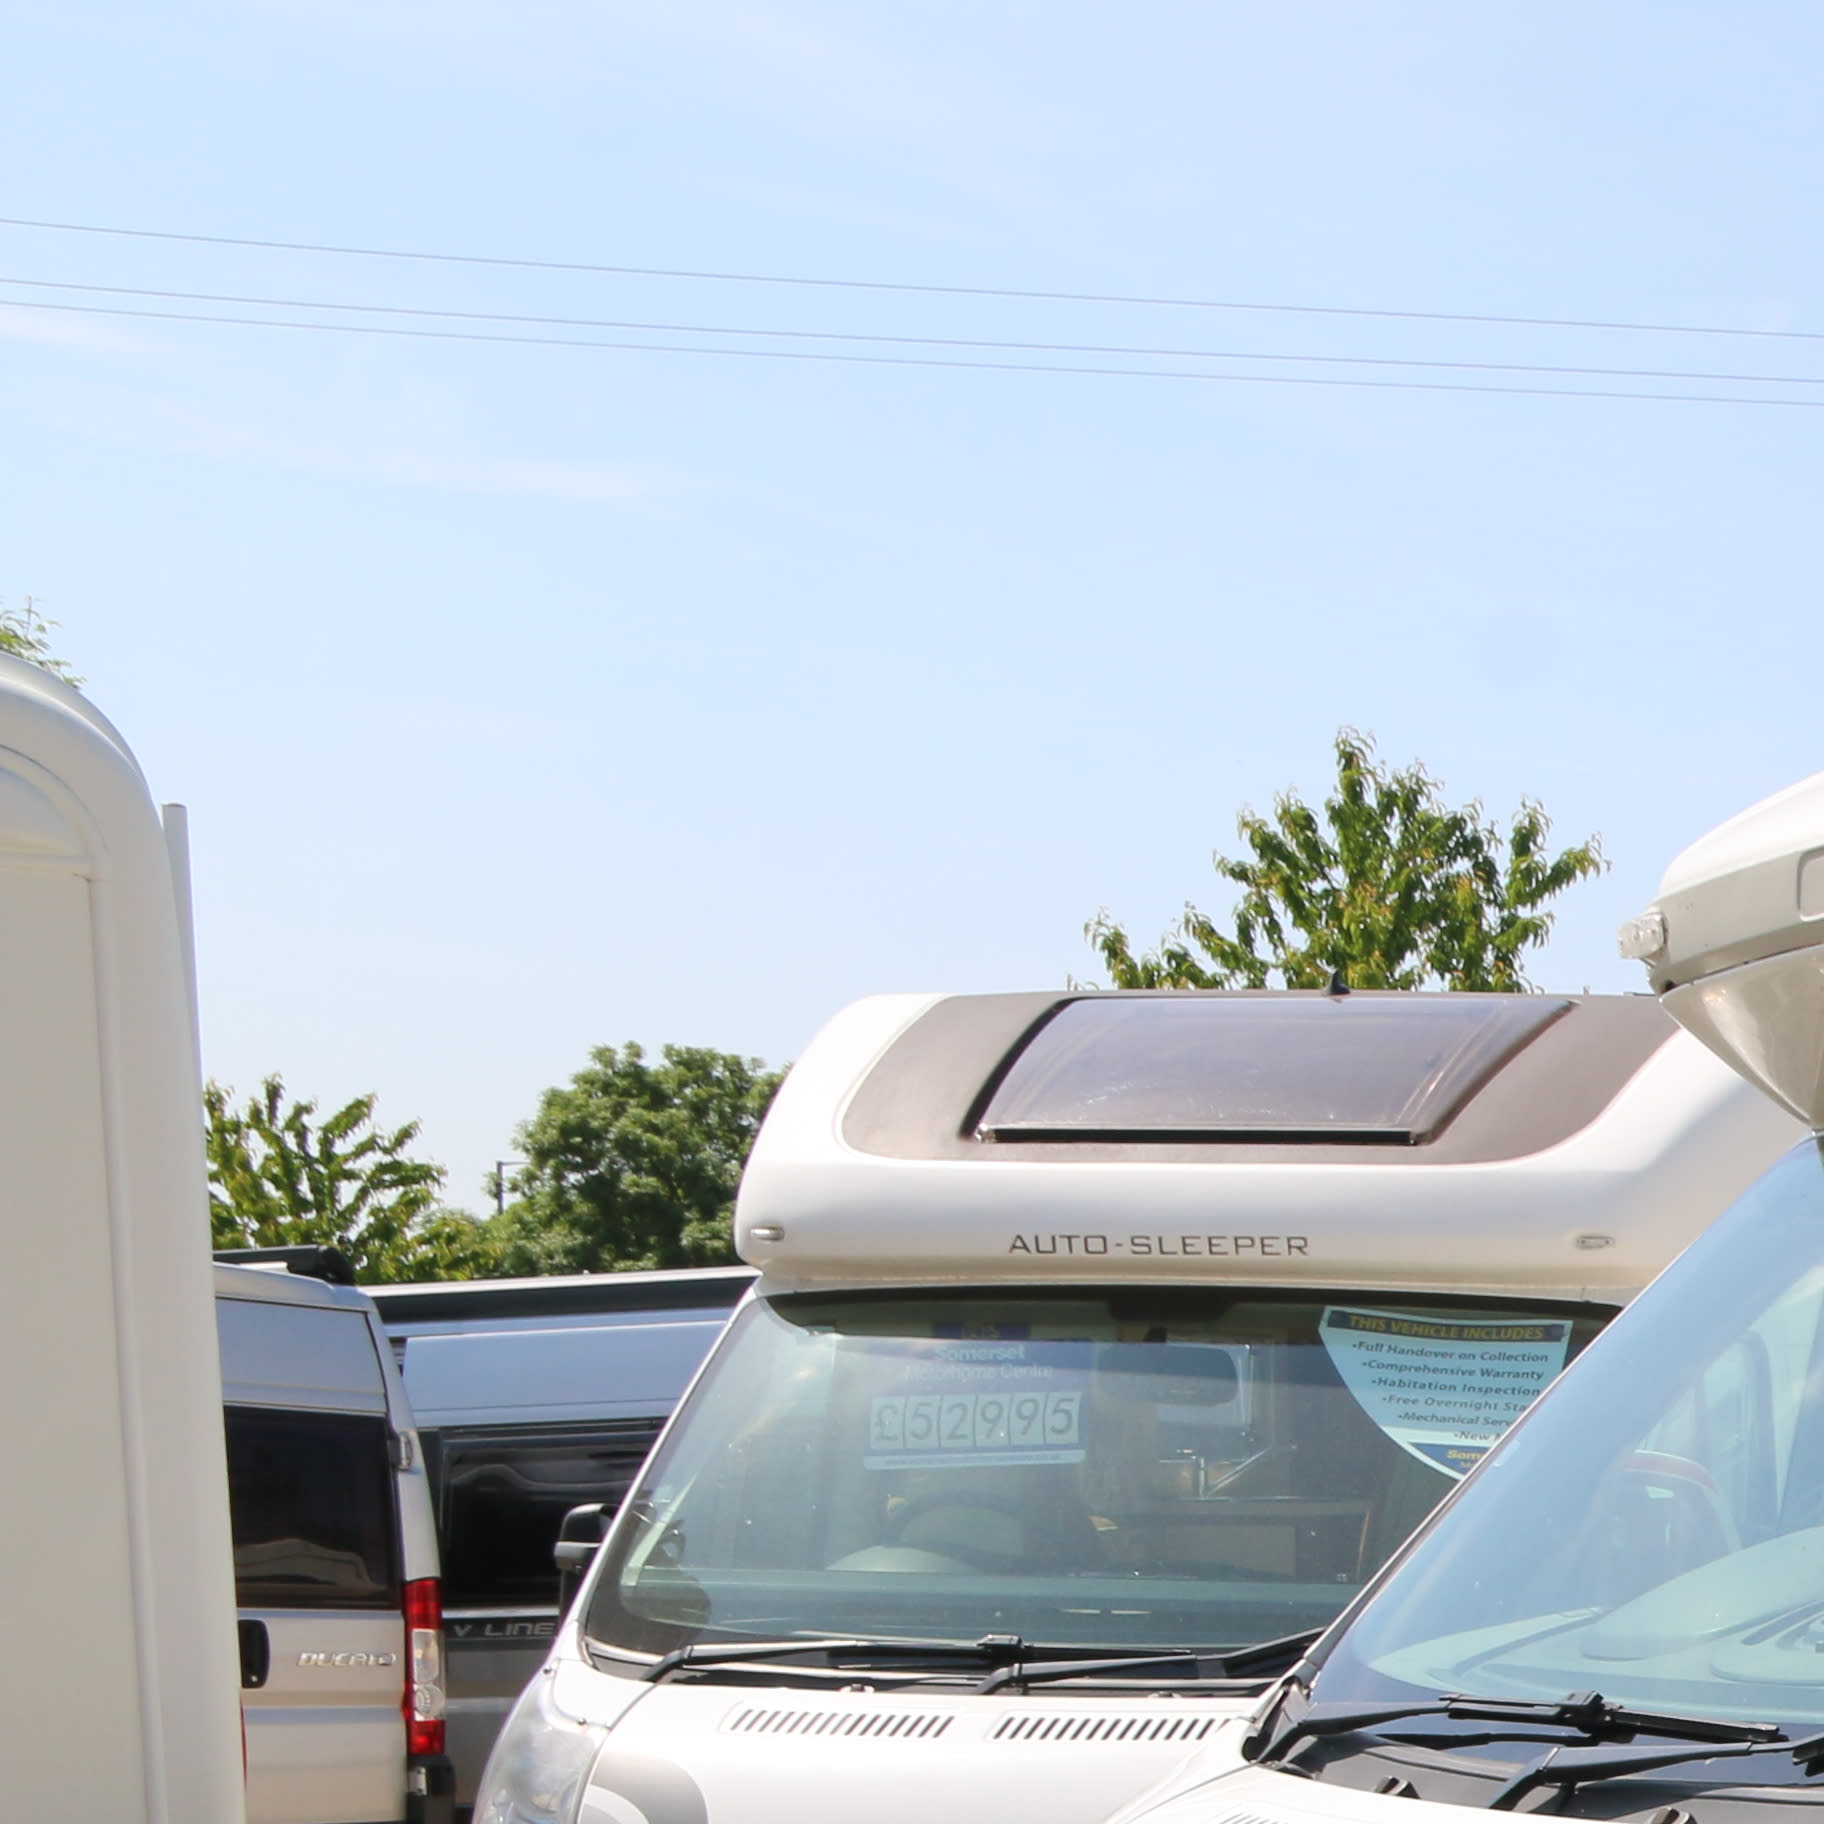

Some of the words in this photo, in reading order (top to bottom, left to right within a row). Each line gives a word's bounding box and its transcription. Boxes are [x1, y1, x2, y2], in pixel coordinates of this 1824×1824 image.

[1008, 1234, 1309, 1256] AUTO-SLEEPER
[1349, 1315, 1386, 1331] THIS
[1390, 1319, 1459, 1338] VEHICLE
[1464, 1326, 1545, 1339] INCLUDES
[1357, 1341, 1385, 1353] Full
[1387, 1344, 1455, 1359] Handover
[1458, 1351, 1476, 1361] on
[1480, 1350, 1549, 1362] Collection
[1367, 1359, 1476, 1377] Comprehensive
[1480, 1367, 1545, 1381] Warranty
[1377, 1376, 1457, 1391] Habitation
[1462, 1383, 1541, 1397] Inspection
[1387, 1394, 1420, 1405] Free
[1424, 1396, 1499, 1411] Overnight
[873, 1398, 1075, 1442] £52995
[1402, 1411, 1480, 1426] Mechanical
[484, 1622, 556, 1637] LINE
[295, 1651, 397, 1667] DUCATO
